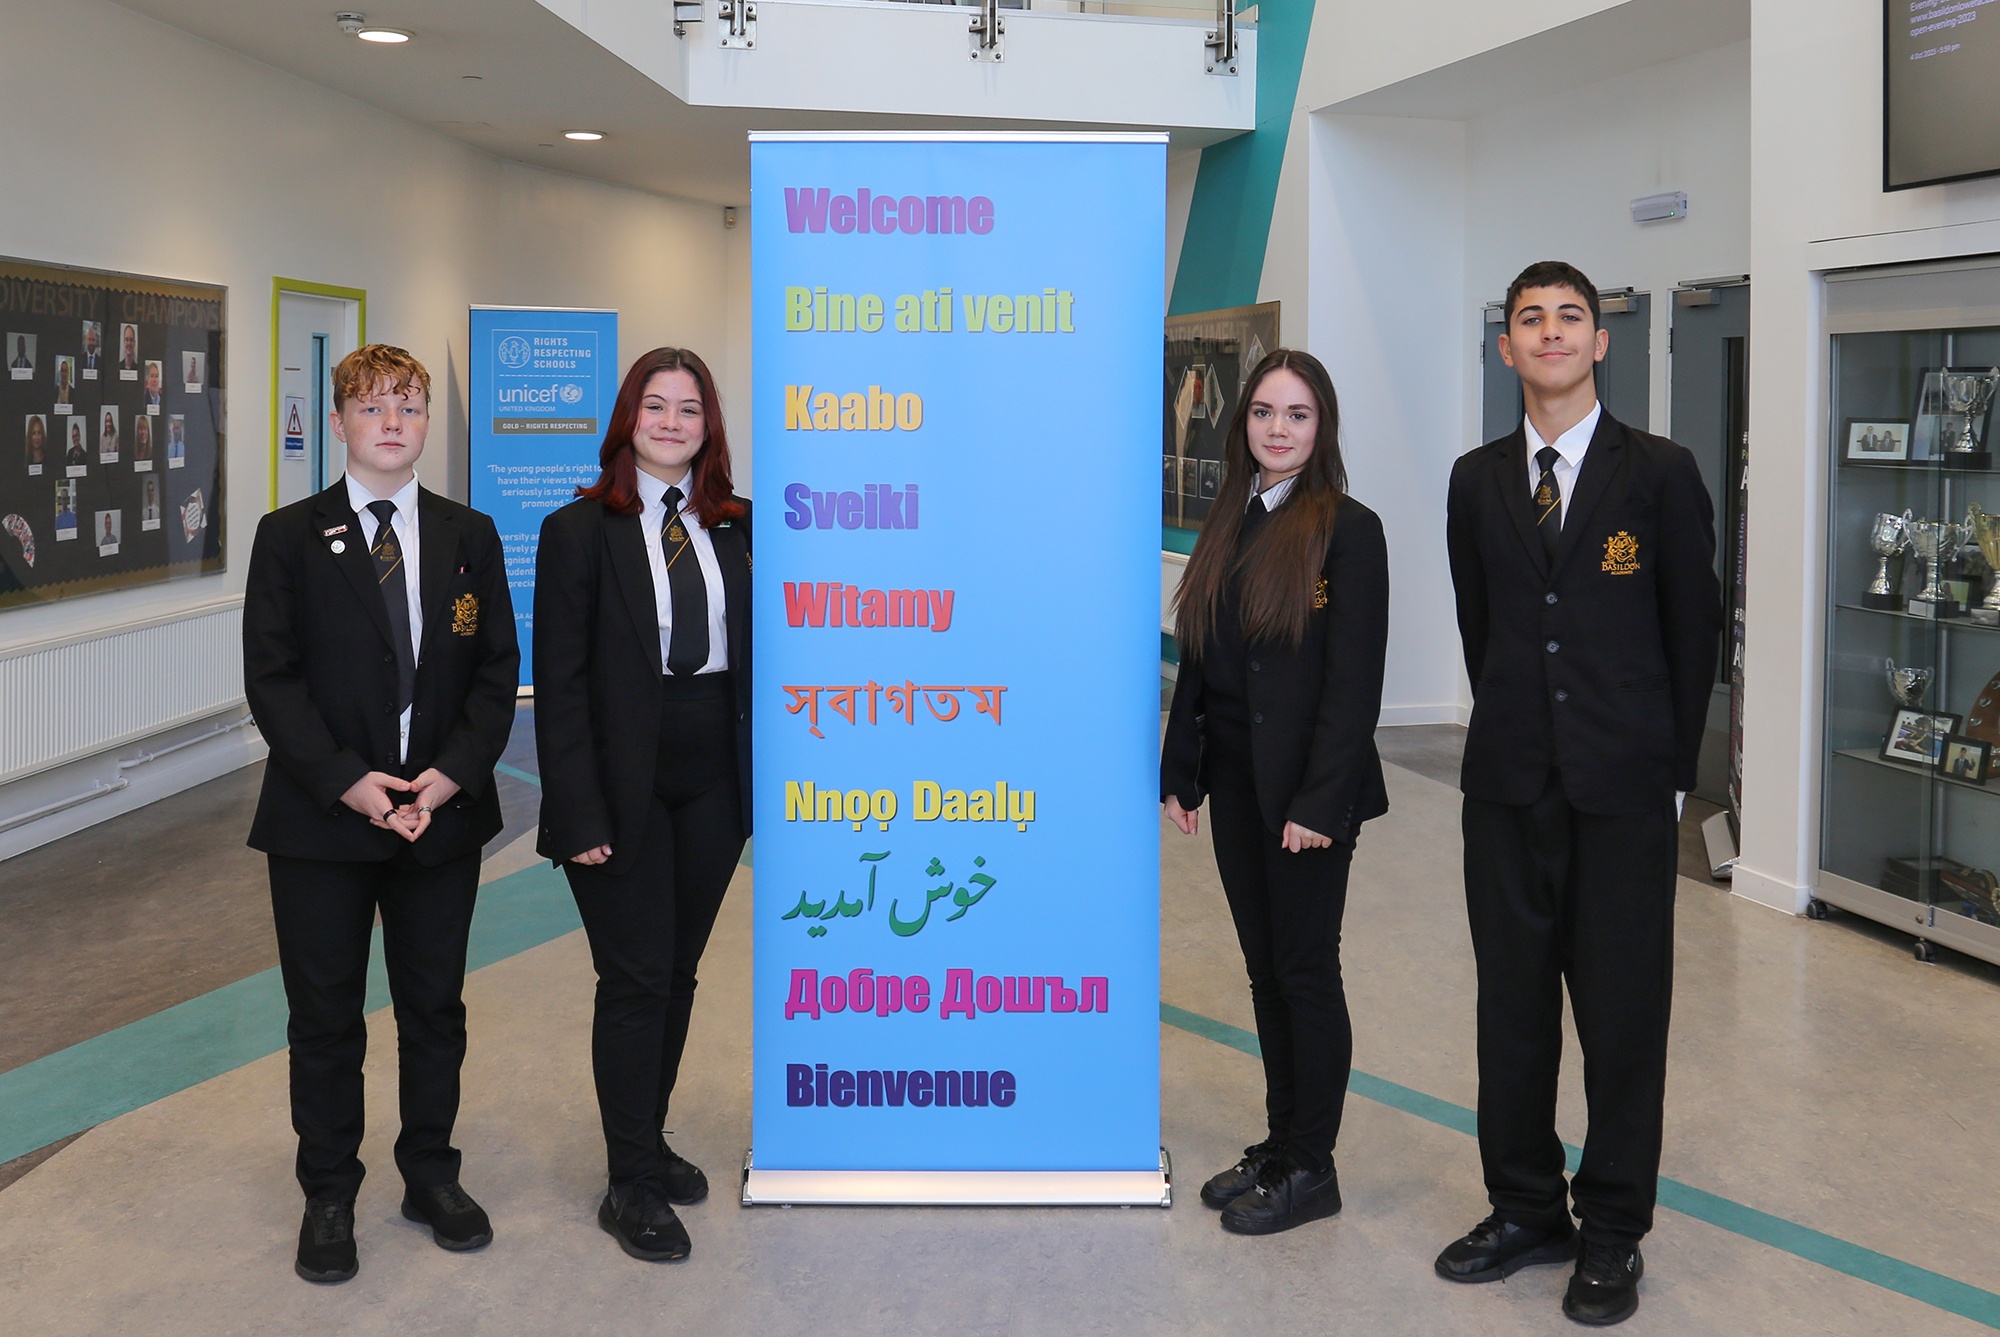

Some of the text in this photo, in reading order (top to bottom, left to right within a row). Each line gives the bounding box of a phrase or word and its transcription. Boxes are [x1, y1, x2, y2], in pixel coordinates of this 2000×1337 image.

[1910, 11, 1976, 37] open-evening-2023
[784, 187, 995, 235] Welcome
[123, 294, 220, 330] CHAMPIONS
[785, 286, 1076, 333] Bine ati venit
[534, 338, 568, 346] RIGHTS
[534, 349, 591, 358] RESPECTING
[534, 360, 576, 369] SCHOOLS
[499, 384, 558, 403] unicef
[785, 384, 924, 432] Kaabo
[498, 477, 519, 485] have
[520, 477, 541, 485] their
[542, 476, 567, 484] views
[507, 466, 534, 475] young
[535, 464, 571, 474] people's
[572, 464, 592, 473] right
[593, 465, 602, 473] to
[502, 488, 575, 497] seriously is stron
[784, 483, 919, 530] Sveiki
[1601, 562, 1641, 571] BASILDON
[1736, 513, 1746, 585] Motivation
[783, 581, 955, 633] Witamy
[785, 780, 1037, 833] Nnọọ Daalụ
[781, 850, 997, 938] خوش آمدید
[785, 967, 1109, 1020] Добре Дошъл
[785, 1063, 1017, 1109] Bienvenue
